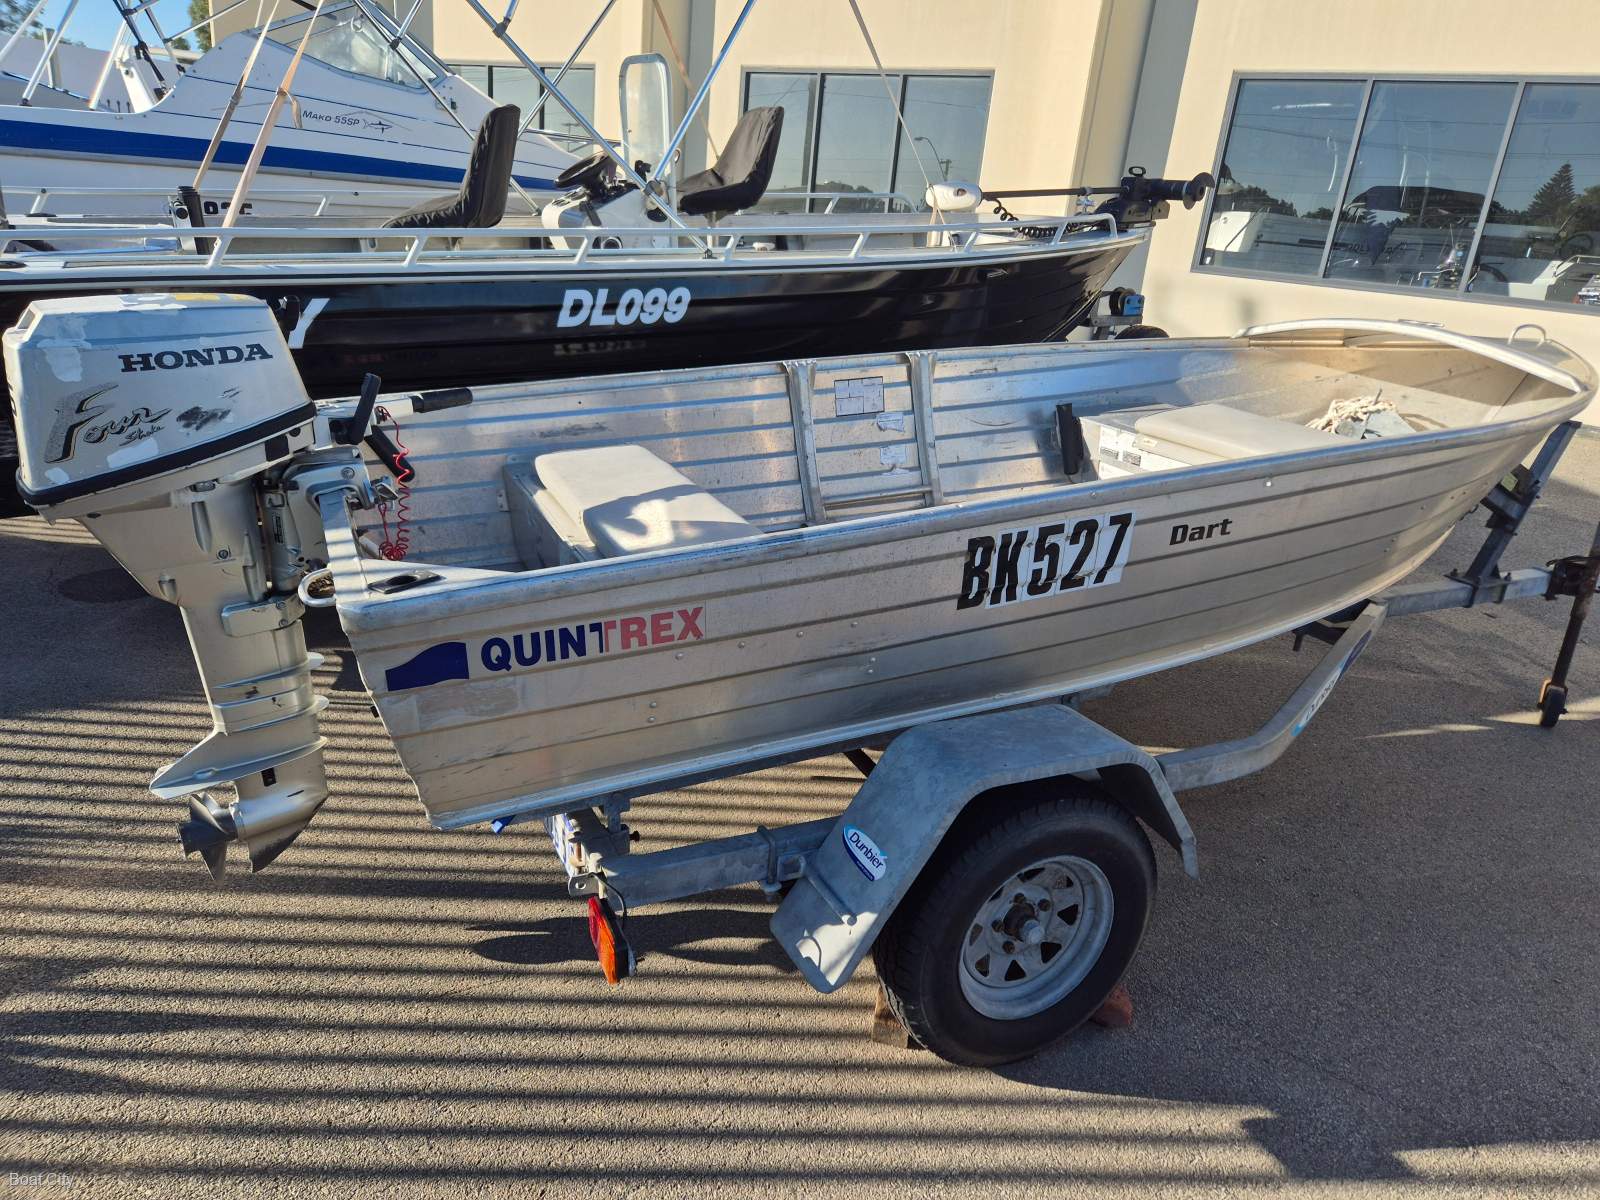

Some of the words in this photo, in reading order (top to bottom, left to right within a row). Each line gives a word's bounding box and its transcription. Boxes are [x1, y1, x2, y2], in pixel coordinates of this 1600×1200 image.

[556, 286, 691, 328] DL099
[118, 343, 274, 373] HONDA
[1169, 518, 1233, 546] Dart
[956, 512, 1133, 611] BK527
[480, 606, 705, 672] QUINTREX
[849, 831, 884, 869] Dunbier
